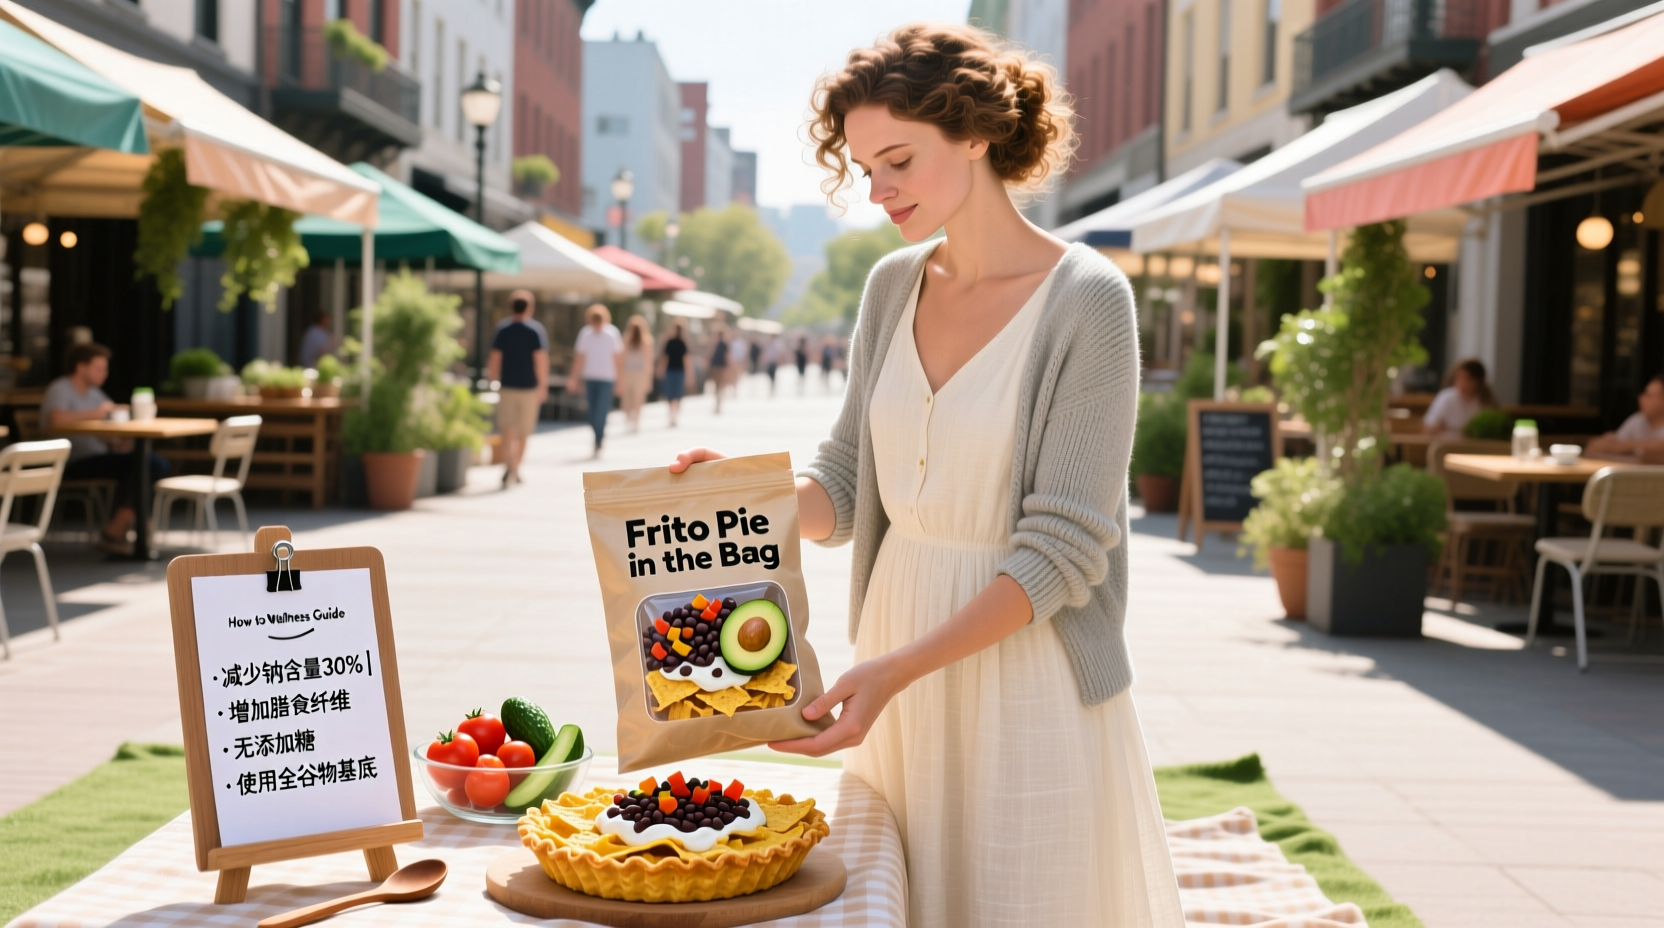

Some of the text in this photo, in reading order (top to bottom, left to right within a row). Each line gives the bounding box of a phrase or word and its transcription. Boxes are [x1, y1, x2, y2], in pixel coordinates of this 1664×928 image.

[625, 506, 770, 549] Frito Pie
[628, 541, 780, 578] in the Bag
[228, 616, 252, 628] How
[312, 606, 346, 621] Guide
[233, 728, 316, 760] 无添加糖
[236, 755, 378, 797] 使用全谷物基底
